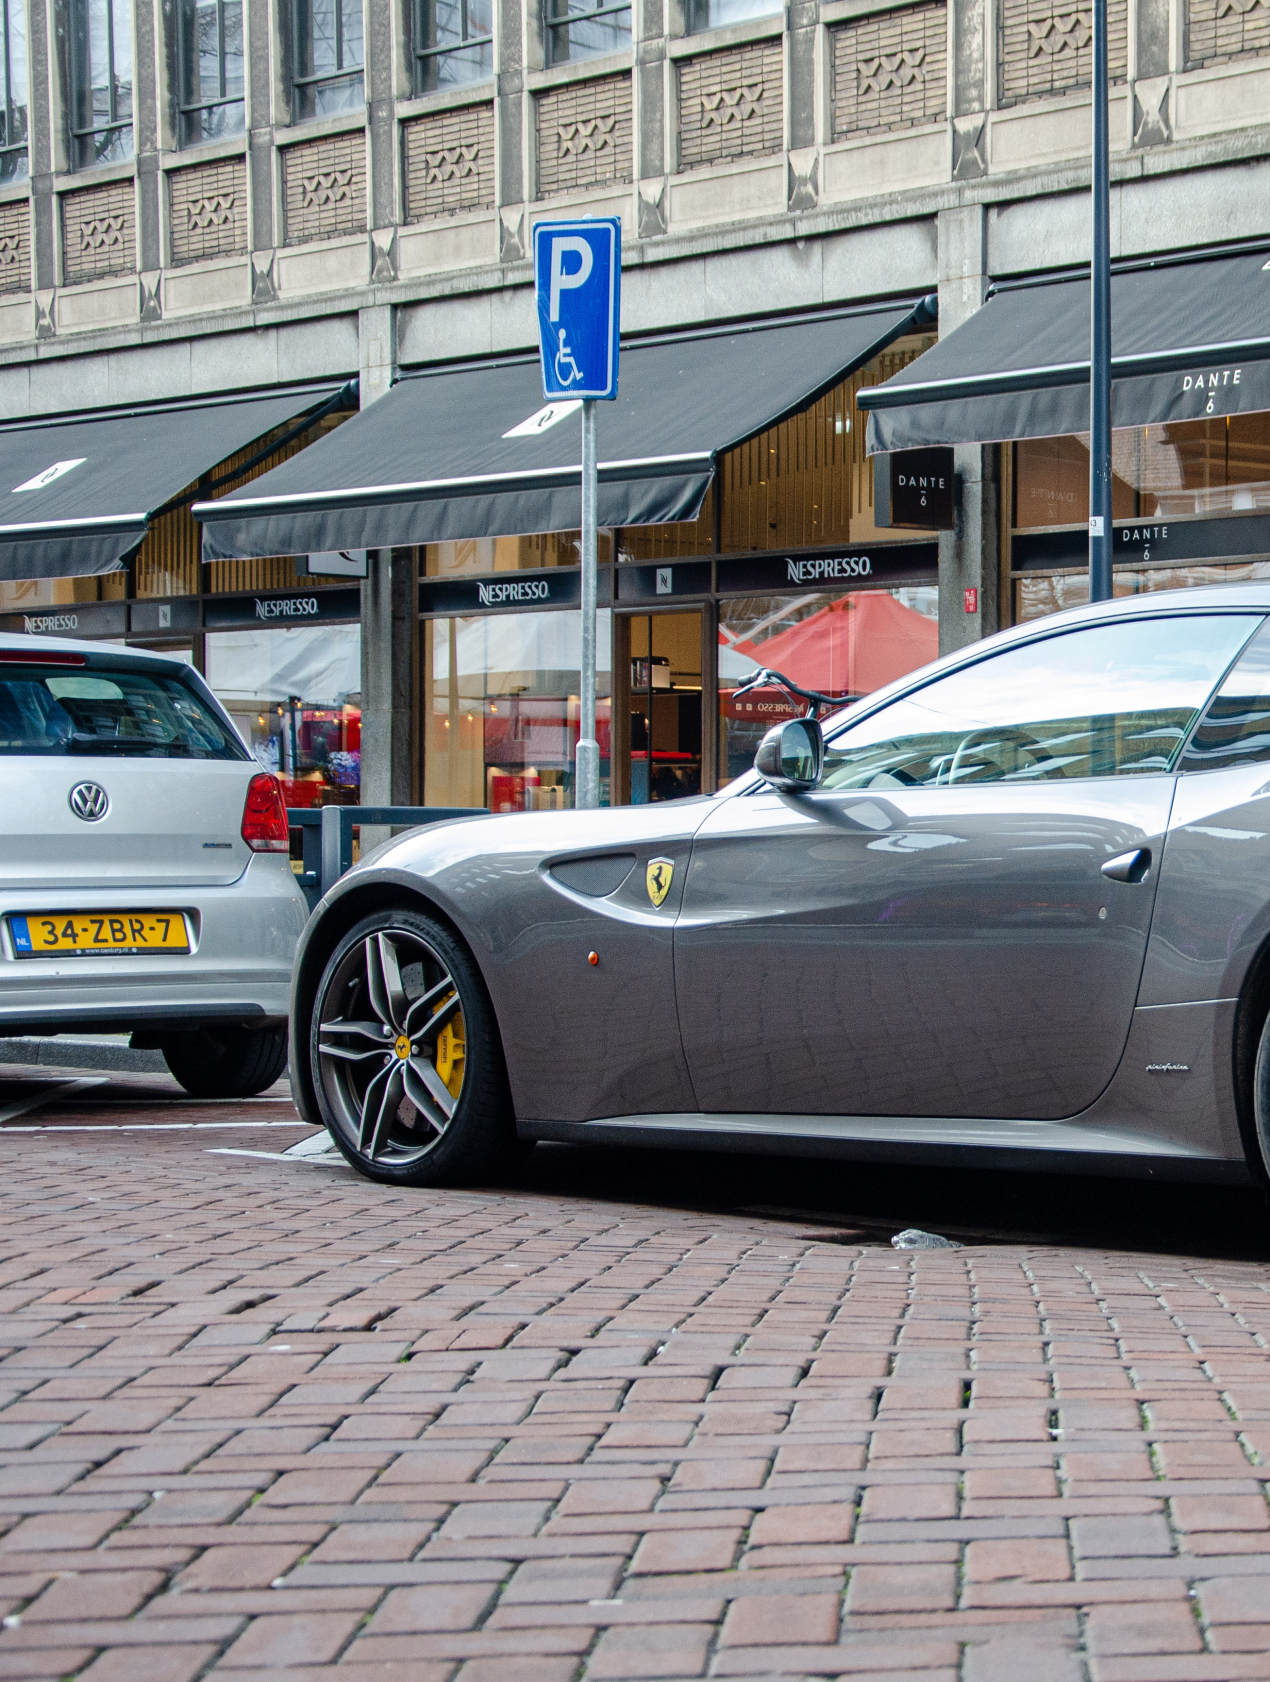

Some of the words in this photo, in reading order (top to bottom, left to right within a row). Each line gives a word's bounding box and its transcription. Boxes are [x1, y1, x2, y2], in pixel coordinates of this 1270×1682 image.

[550, 236, 594, 322] P
[1182, 369, 1242, 391] DANTE
[1206, 398, 1214, 414] 6
[898, 474, 945, 489] DANTE
[920, 495, 927, 506] 6
[1122, 526, 1169, 541] DANTE
[1143, 548, 1150, 561] 6
[785, 556, 871, 584] NESPRESSO
[476, 580, 549, 606] NESPRESSO
[254, 597, 318, 621] NESPRESSO
[23, 614, 78, 635] NESPRESSO
[16, 937, 30, 947] NL
[40, 918, 172, 946] 34-ZBR-7
